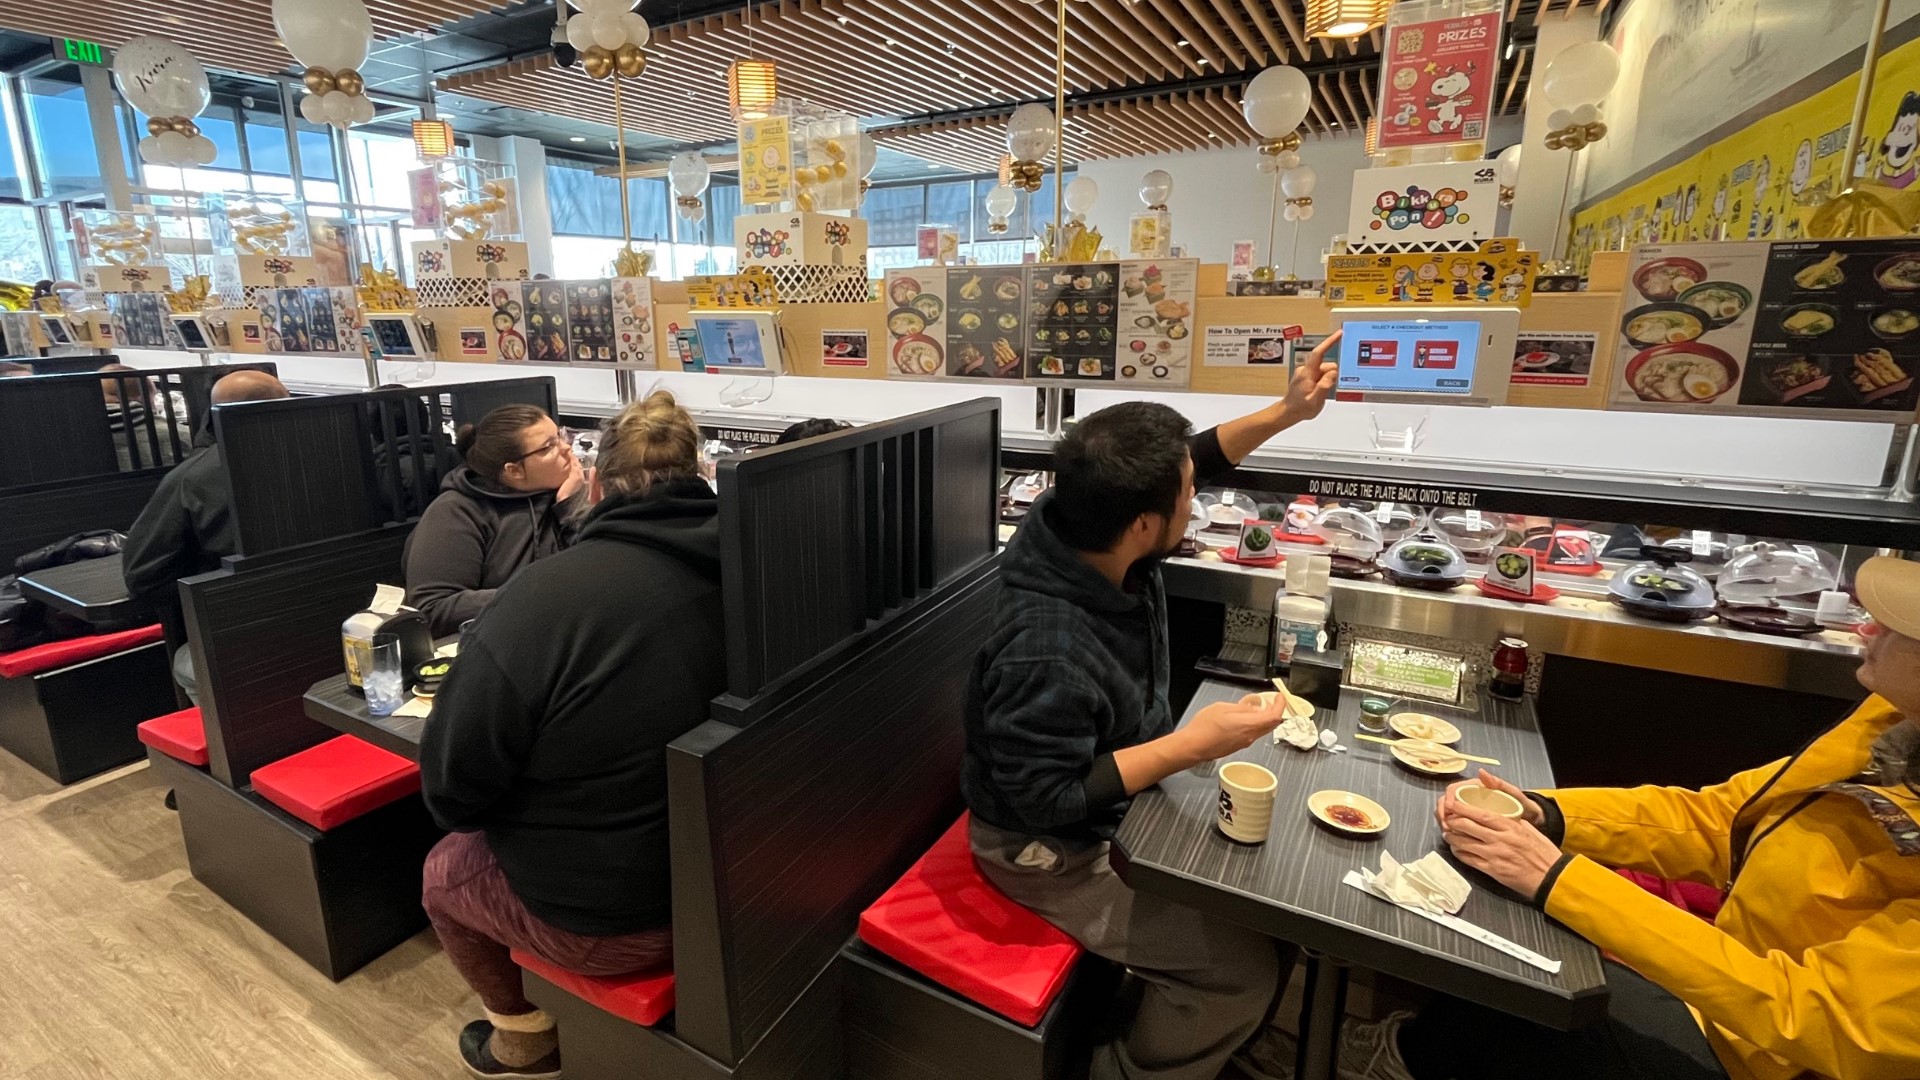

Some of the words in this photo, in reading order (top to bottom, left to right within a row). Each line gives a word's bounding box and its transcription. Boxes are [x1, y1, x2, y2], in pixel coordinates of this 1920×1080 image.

[1438, 26, 1487, 44] PRIZES
[64, 37, 103, 64] EXIT
[135, 55, 176, 93] Kura
[761, 126, 784, 136] PRIZES
[718, 430, 723, 438] DO
[731, 431, 742, 441] PLACE
[750, 433, 760, 442] PLATE
[760, 433, 770, 443] BACK
[1309, 480, 1319, 493] DO
[1321, 481, 1335, 494] NOT
[1336, 482, 1358, 497] PLACE
[1360, 483, 1373, 498] THE
[1375, 485, 1396, 500] PLATE
[1399, 487, 1418, 502] BACK
[1420, 489, 1439, 503] ONTO
[1442, 491, 1456, 505] THE
[1458, 492, 1477, 507] BELT
